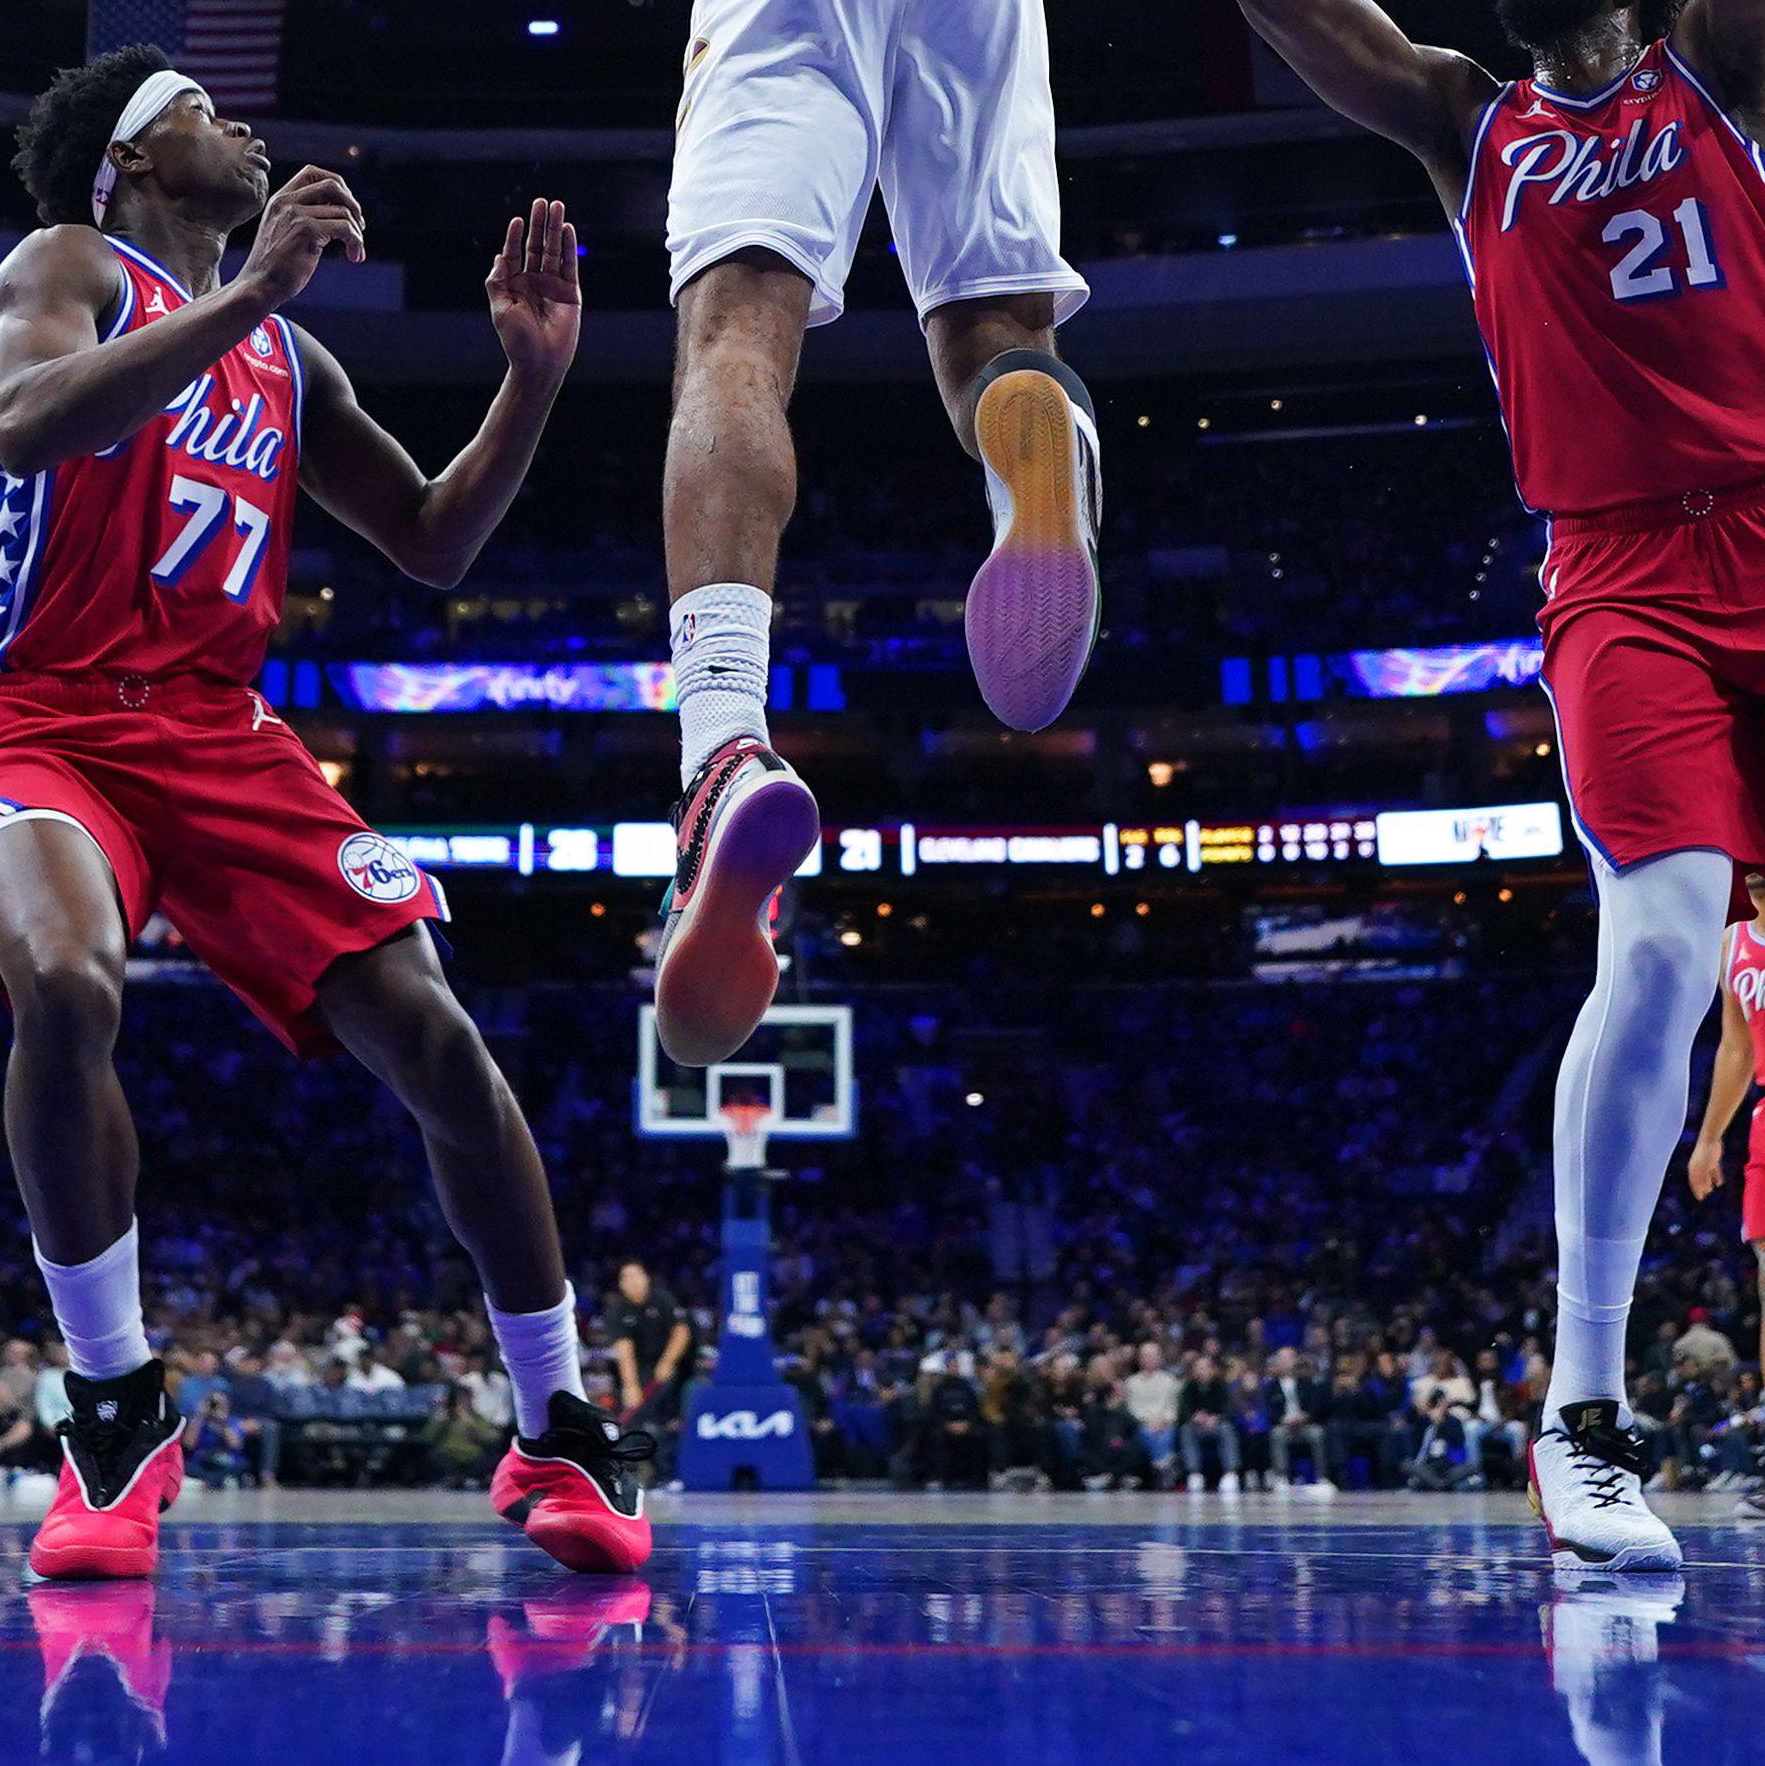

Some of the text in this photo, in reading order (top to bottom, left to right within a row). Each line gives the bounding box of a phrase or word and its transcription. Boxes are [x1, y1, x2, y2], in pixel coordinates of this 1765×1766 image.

[1501, 120, 1684, 232] Phila
[1601, 197, 1718, 300] 21
[164, 373, 285, 480] hila
[150, 474, 270, 597] 77
[1577, 1407, 1603, 1431] JE
